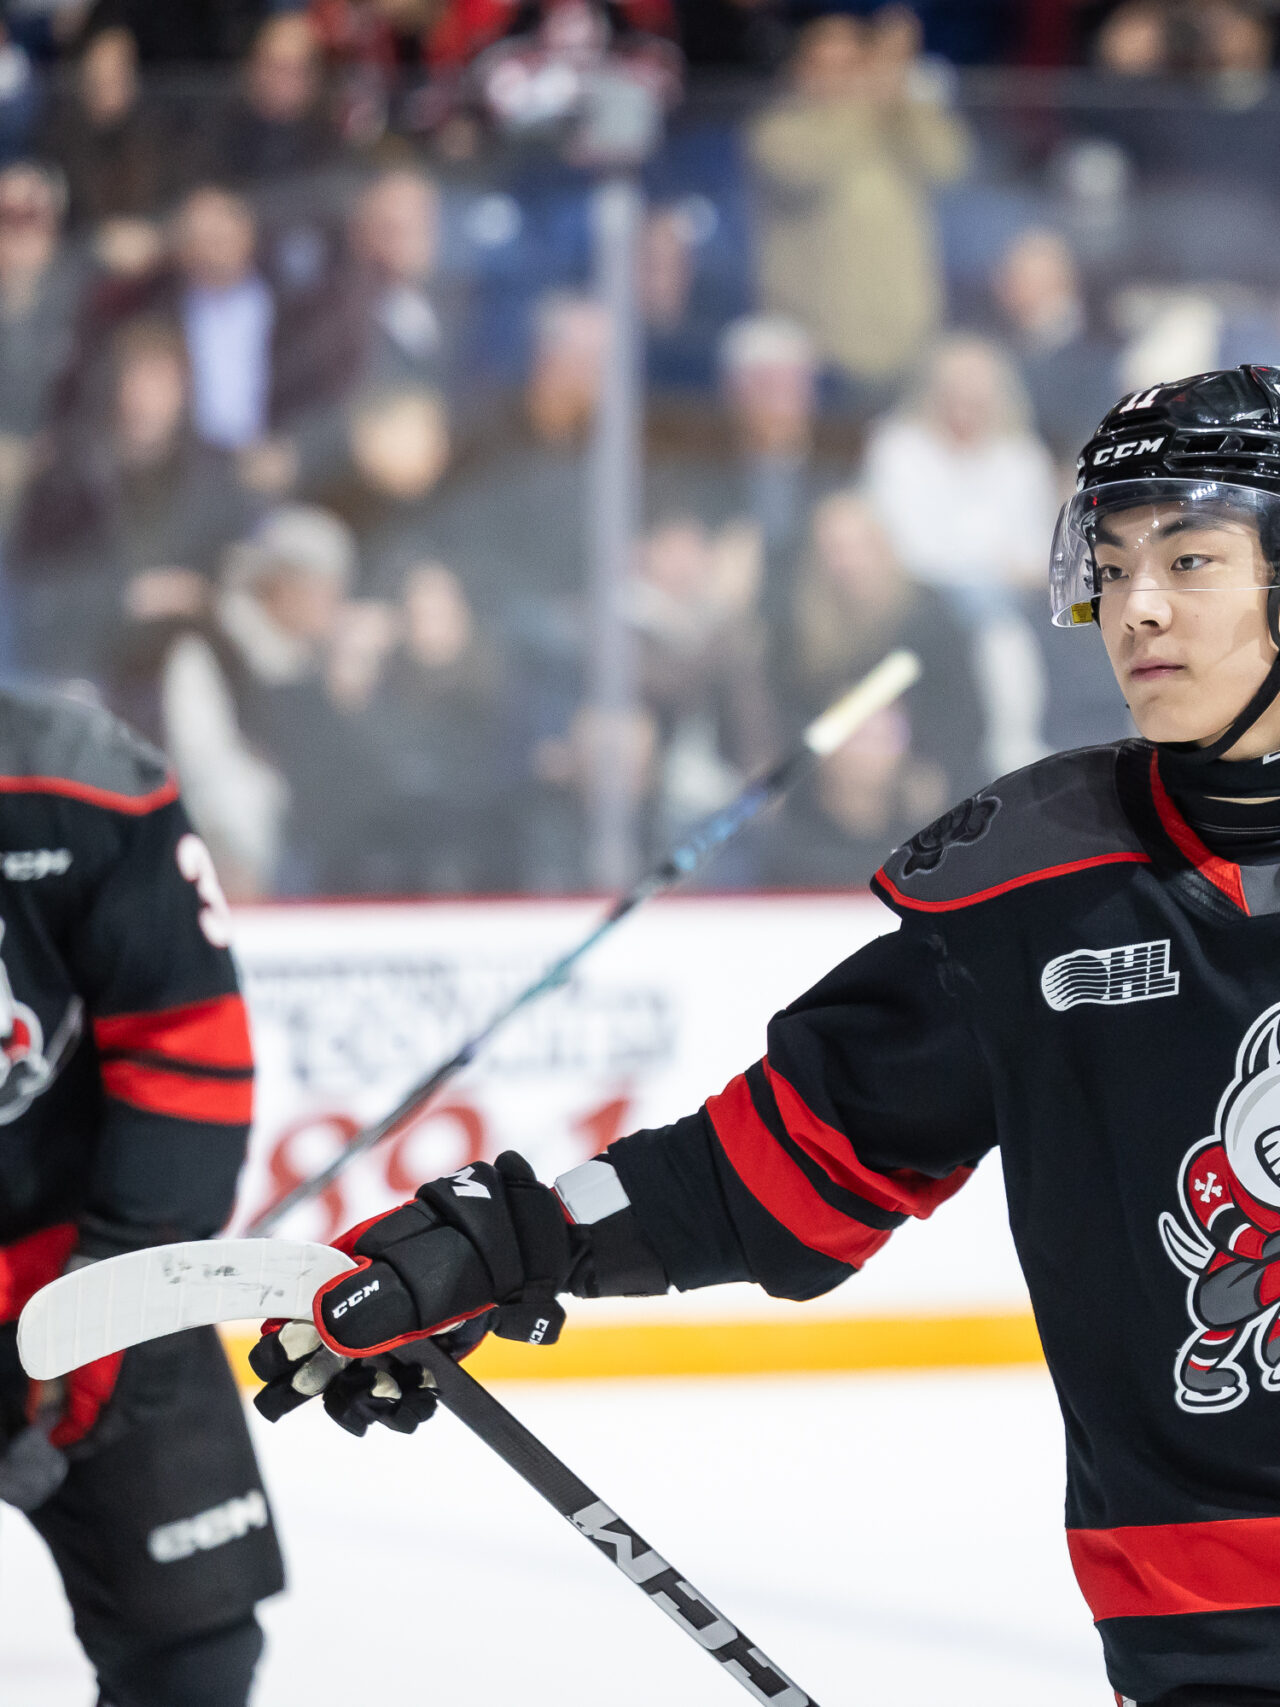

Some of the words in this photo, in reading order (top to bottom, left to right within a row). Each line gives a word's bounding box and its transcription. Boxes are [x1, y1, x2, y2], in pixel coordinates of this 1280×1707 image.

[1092, 437, 1165, 467] CCM
[1041, 939, 1180, 1011] OHL
[331, 1279, 380, 1319] CCM
[528, 1318, 550, 1345] CC
[565, 1498, 813, 1707] CCM
